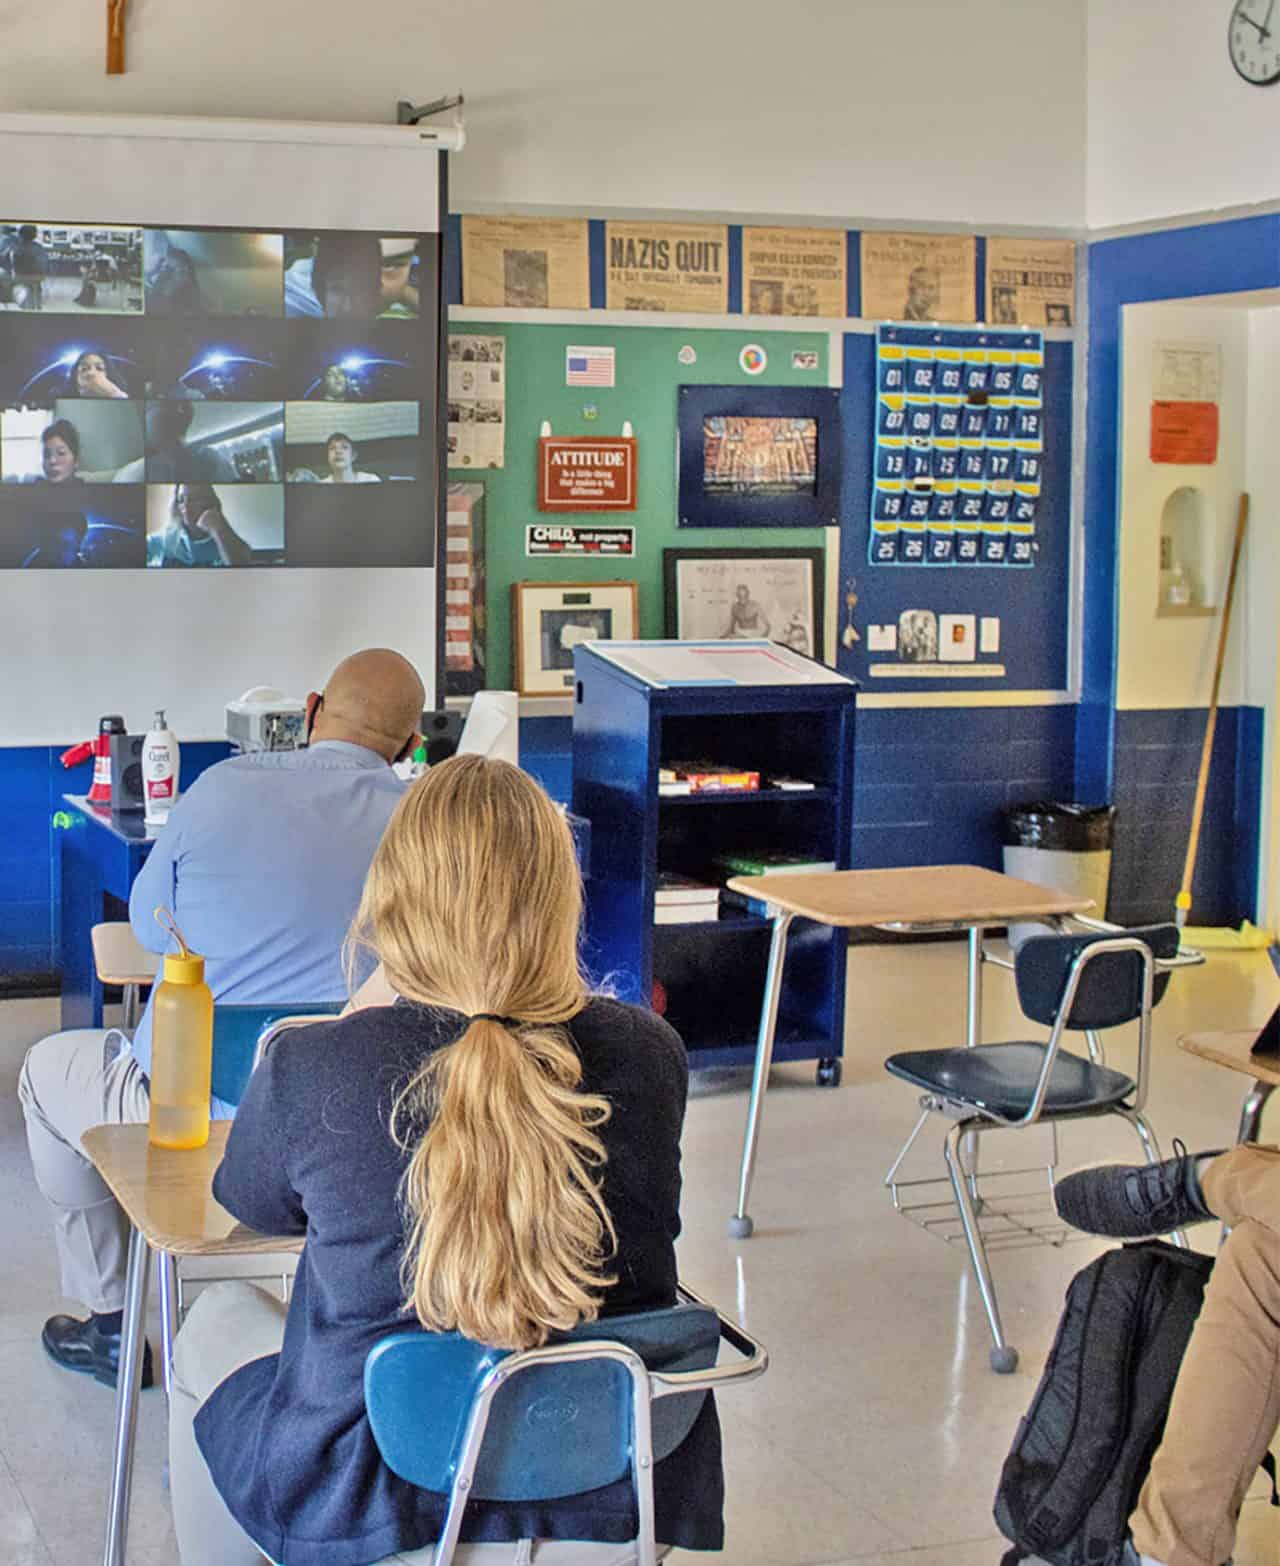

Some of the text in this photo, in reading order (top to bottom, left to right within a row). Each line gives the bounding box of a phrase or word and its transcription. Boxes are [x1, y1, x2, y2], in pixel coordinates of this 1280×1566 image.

[610, 236, 722, 273] NAZIS QUIT
[885, 369, 902, 386] 01
[914, 369, 933, 387] 02
[942, 370, 961, 387] 03
[969, 372, 986, 388] 04
[994, 372, 1012, 389] 05
[1021, 373, 1041, 390] 06
[885, 412, 905, 428] 07
[913, 413, 931, 429] 08
[940, 414, 958, 431] 09
[995, 416, 1009, 431] 11
[1021, 415, 1038, 432] 12
[551, 451, 625, 467] ATTITUDE
[886, 456, 903, 472] 13
[940, 457, 955, 473] 15
[966, 457, 982, 473] 16
[991, 456, 1009, 472] 17
[1021, 459, 1038, 476] 18
[884, 499, 901, 514] 19
[910, 500, 929, 515] 20
[938, 500, 954, 515] 21
[963, 499, 982, 515] 22
[990, 501, 1009, 517] 23
[1017, 502, 1035, 518] 24
[533, 527, 577, 543] CHILD,
[877, 542, 895, 558] 25
[905, 541, 923, 557] 26
[933, 541, 952, 557] 27
[959, 541, 977, 557] 28
[987, 542, 1005, 558] 29
[1013, 543, 1031, 558] 30
